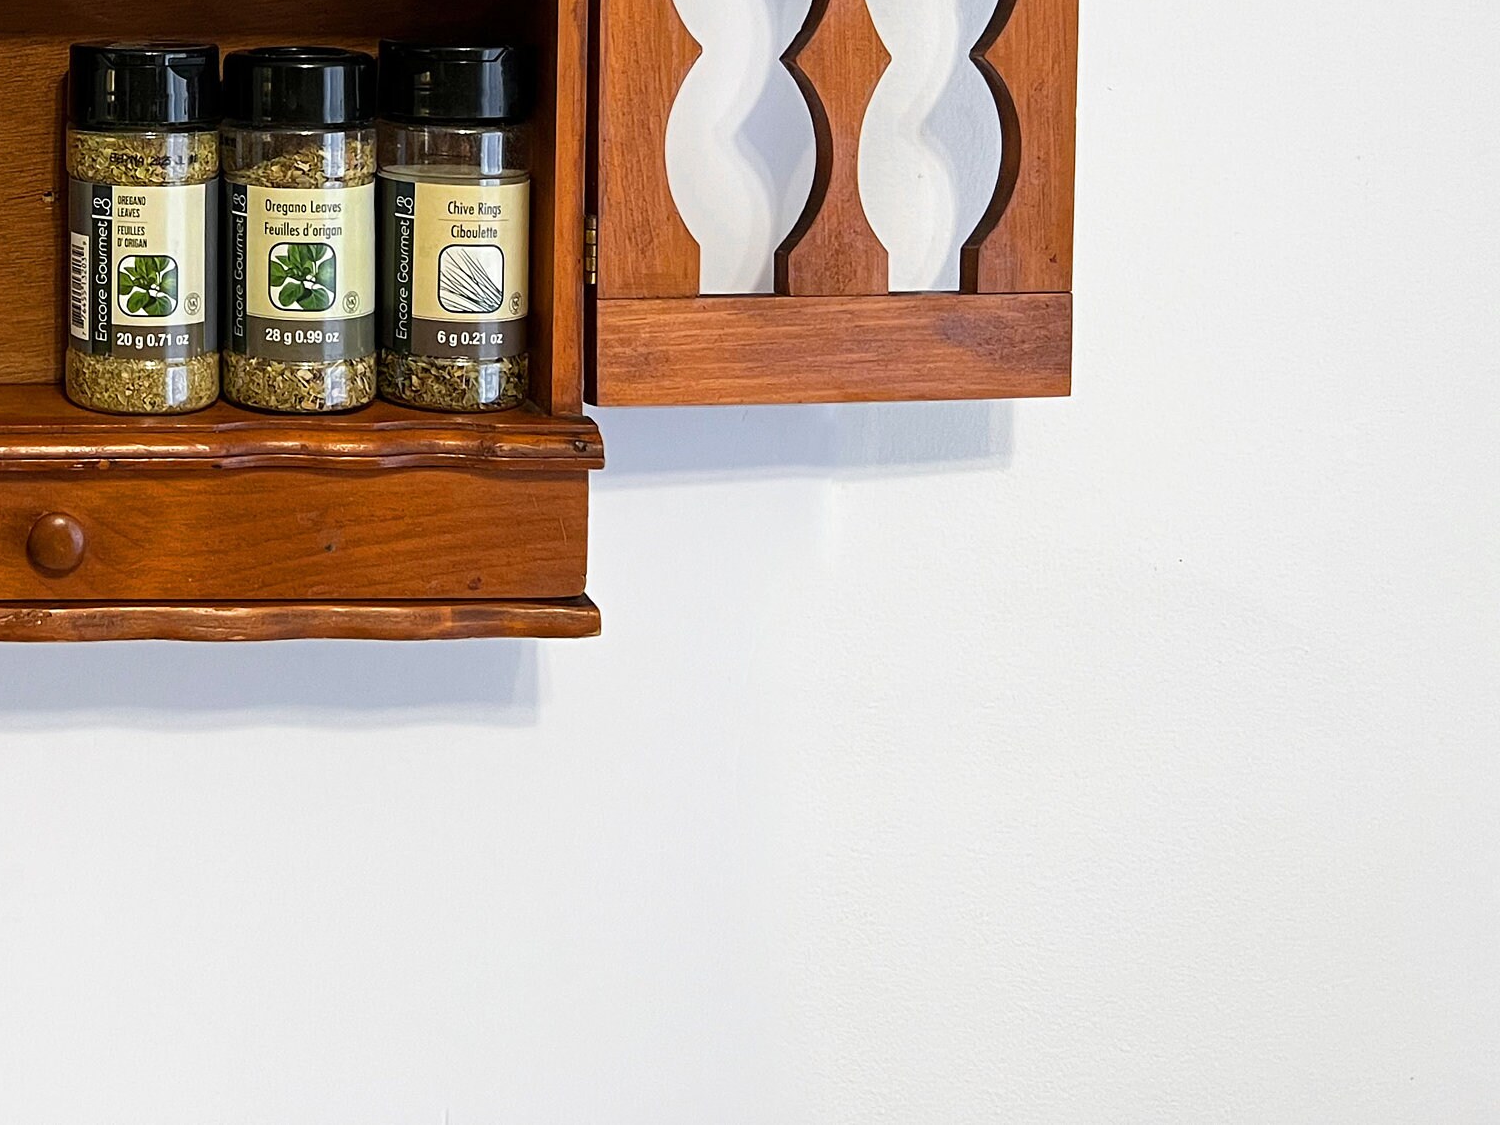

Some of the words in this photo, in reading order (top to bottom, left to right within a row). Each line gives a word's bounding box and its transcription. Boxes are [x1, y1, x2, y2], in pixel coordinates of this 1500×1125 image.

[117, 195, 146, 206] OREGANO
[265, 199, 307, 215] Oregano
[310, 200, 342, 213] Leaves
[117, 208, 140, 218] LEAVES
[448, 201, 474, 215] Chive
[478, 203, 501, 218] Rings
[117, 226, 145, 236] FEUILLES
[264, 222, 300, 236] Feuilles
[303, 222, 342, 239] d'origan
[451, 225, 498, 238] Ciboulette
[96, 220, 108, 285] Gourmet
[234, 217, 244, 280] Gourmet
[397, 220, 410, 283] Gourmet
[95, 289, 108, 342] Encore
[235, 284, 244, 337] Encore
[396, 287, 409, 340] Encore
[117, 332, 132, 346] 20
[135, 335, 144, 349] g
[147, 333, 172, 346] 0.71
[176, 334, 189, 345] oz
[265, 328, 281, 342] 28
[284, 332, 292, 345] g
[295, 330, 323, 343] 0.99
[325, 332, 340, 342] oz
[437, 331, 446, 343] 6
[449, 332, 458, 346] g
[461, 332, 486, 345] 0.21
[490, 333, 503, 344] oz
